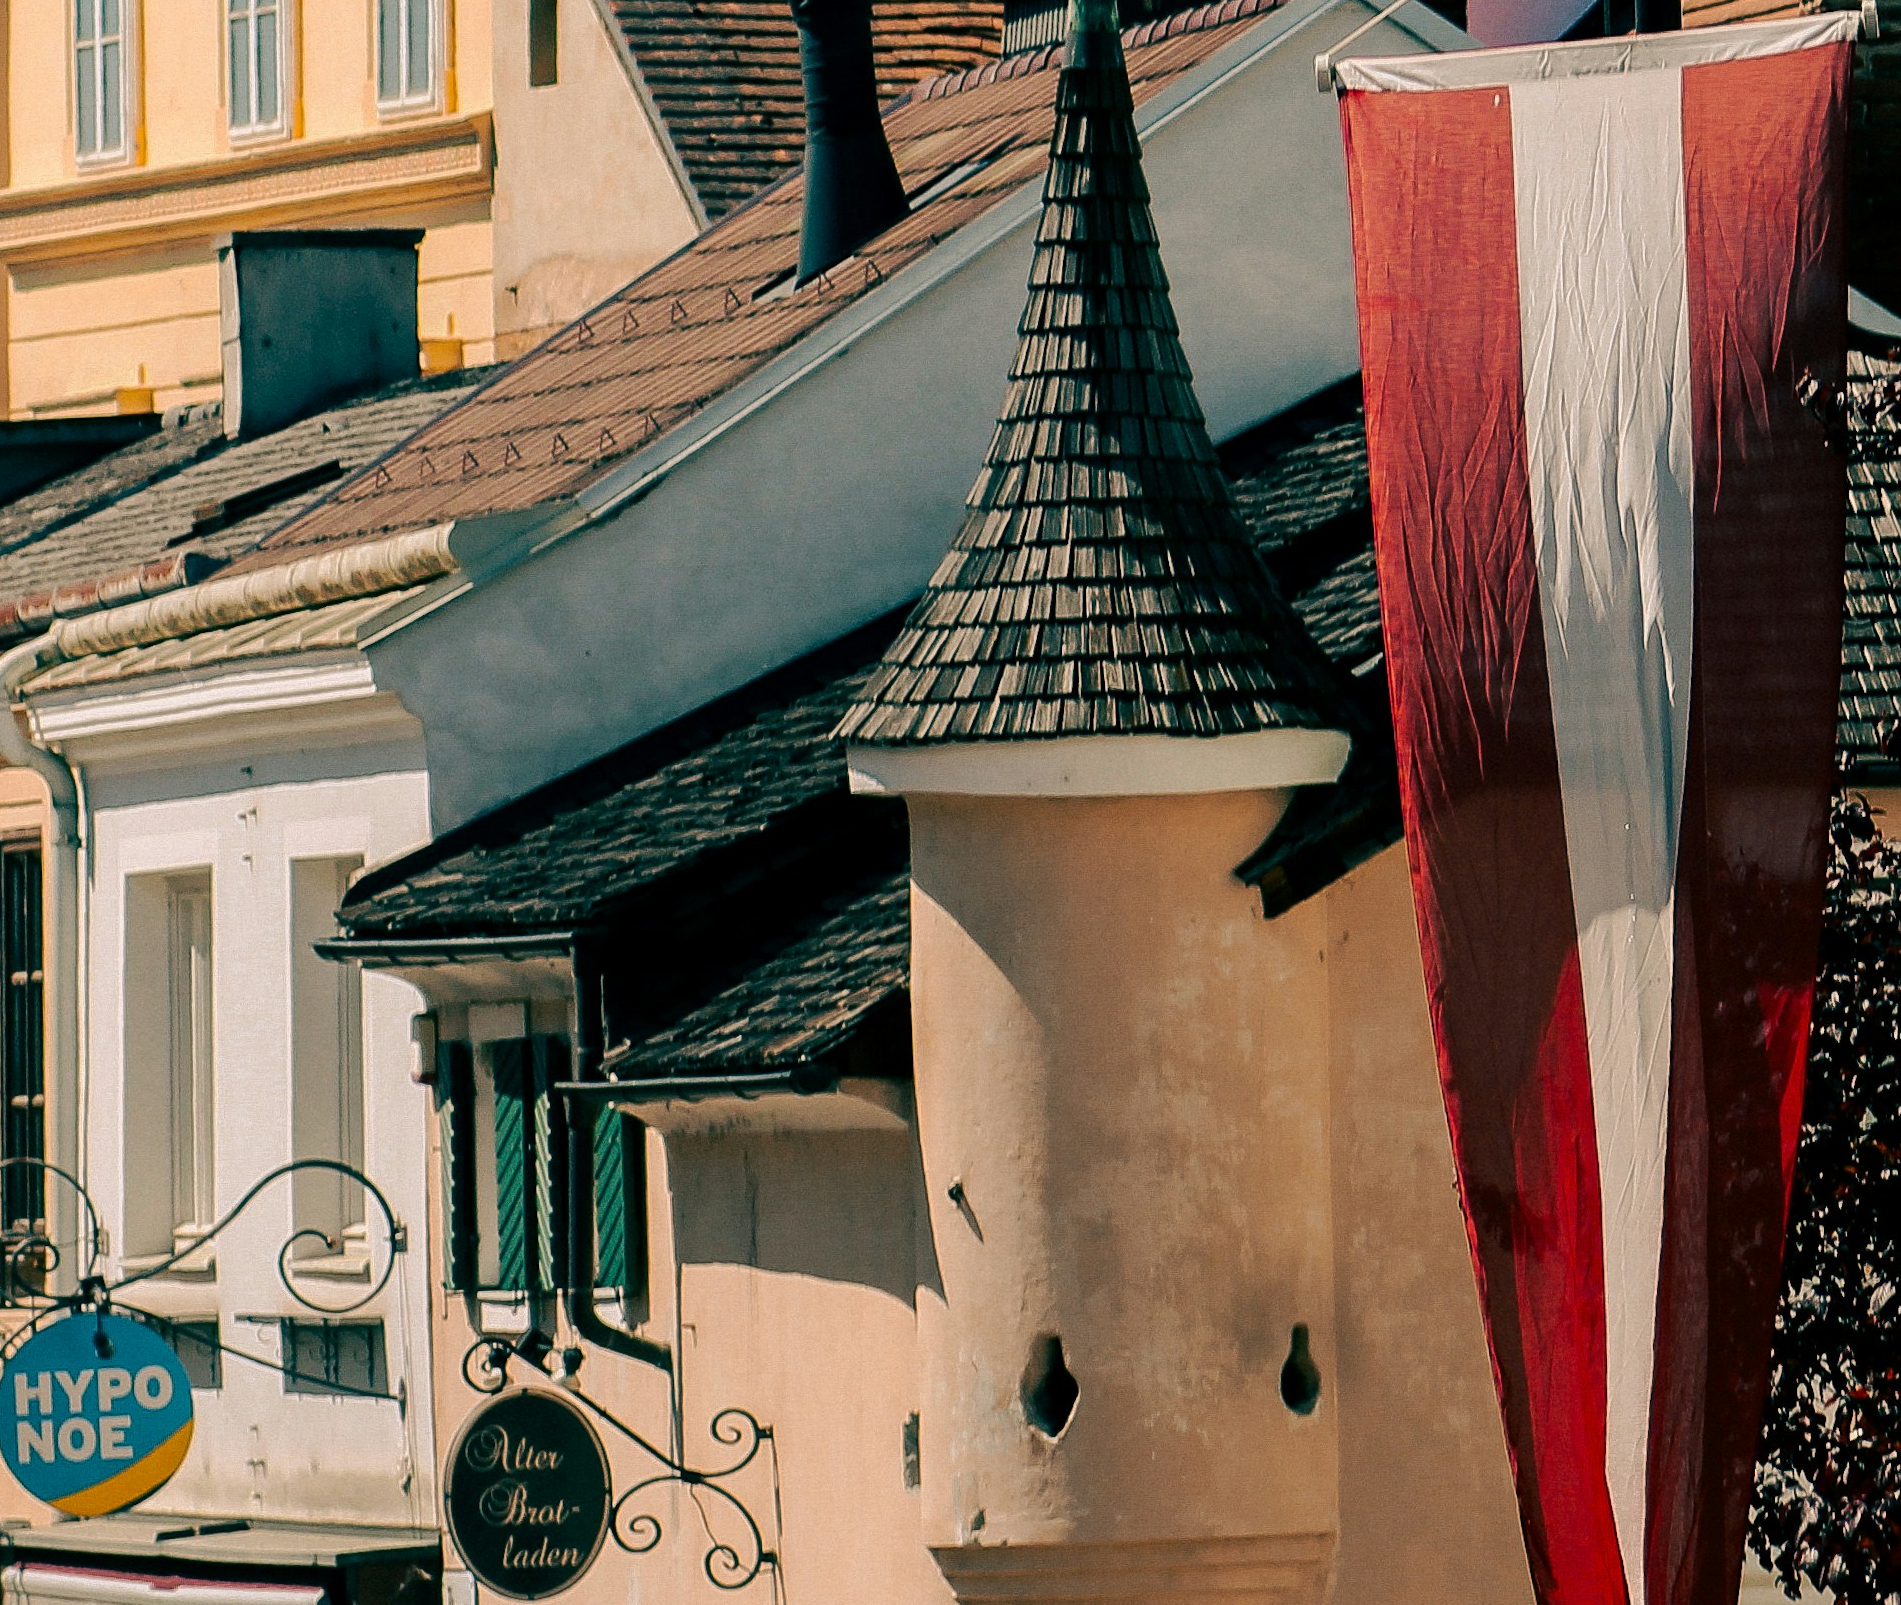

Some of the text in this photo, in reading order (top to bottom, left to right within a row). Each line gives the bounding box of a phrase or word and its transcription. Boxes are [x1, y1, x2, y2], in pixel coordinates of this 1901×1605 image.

[14, 1364, 174, 1417] HYPO
[16, 1414, 134, 1465] NOE
[465, 1424, 564, 1474] Alter
[479, 1478, 581, 1526] Brot-
[503, 1535, 585, 1570] laden
